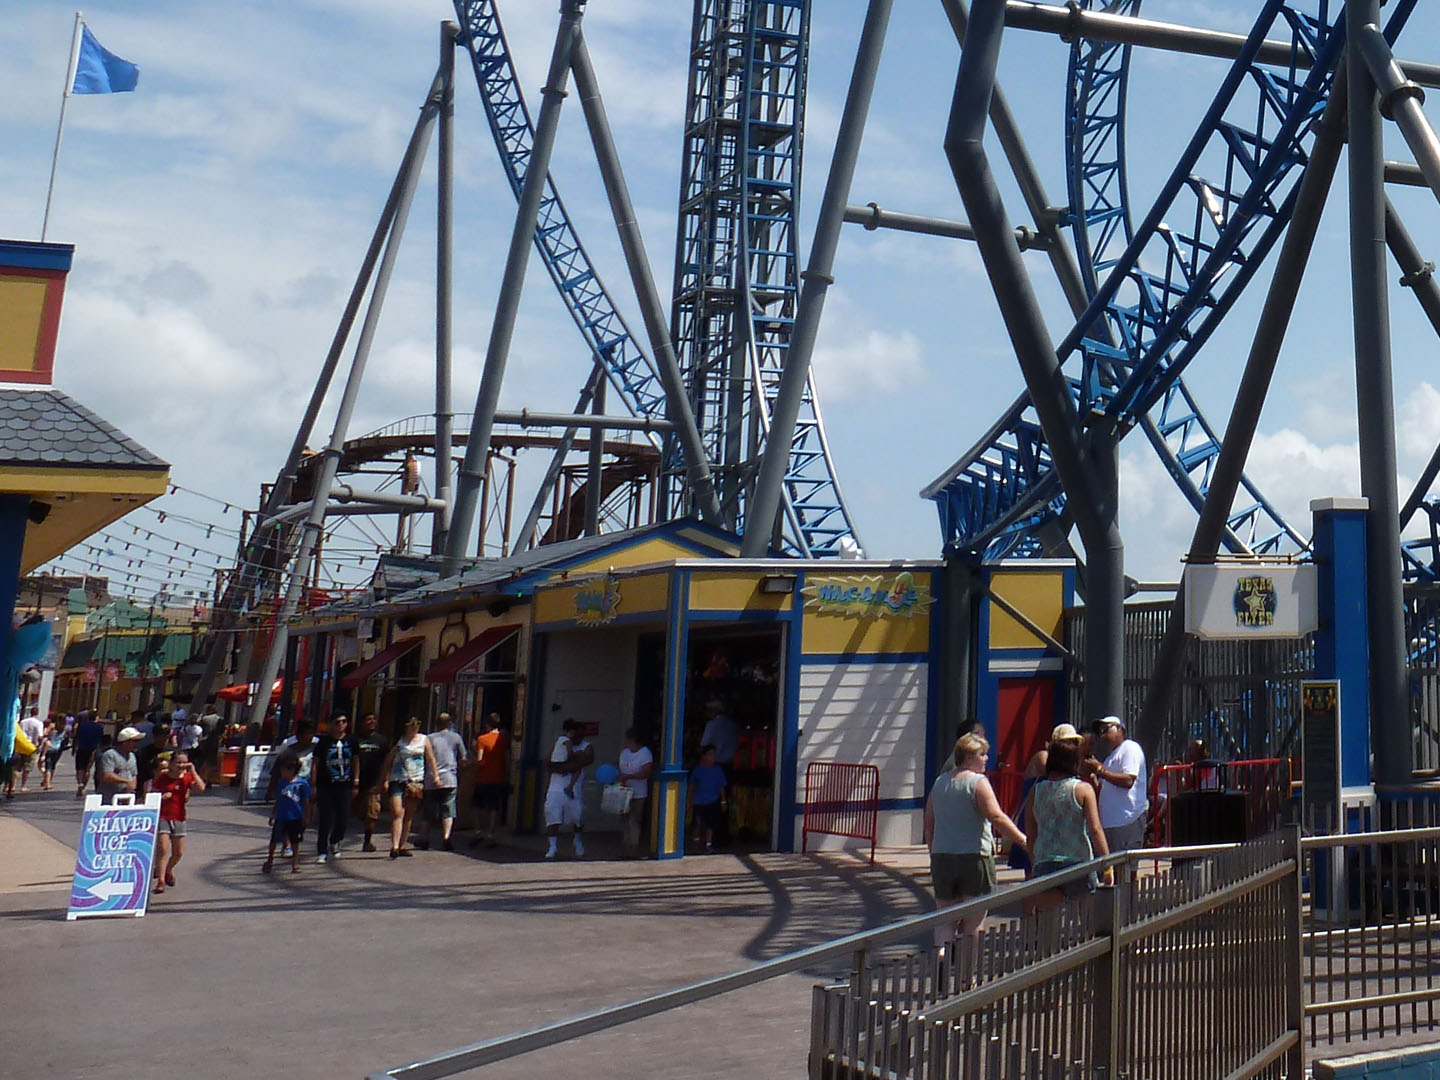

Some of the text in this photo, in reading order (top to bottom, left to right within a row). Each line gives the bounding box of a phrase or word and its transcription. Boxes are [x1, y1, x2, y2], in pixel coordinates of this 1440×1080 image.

[1237, 576, 1273, 591] TEXAS
[1237, 611, 1274, 625] FLYER
[87, 817, 152, 833] SHAVED
[100, 835, 128, 851] ICE
[92, 853, 137, 869] CART
